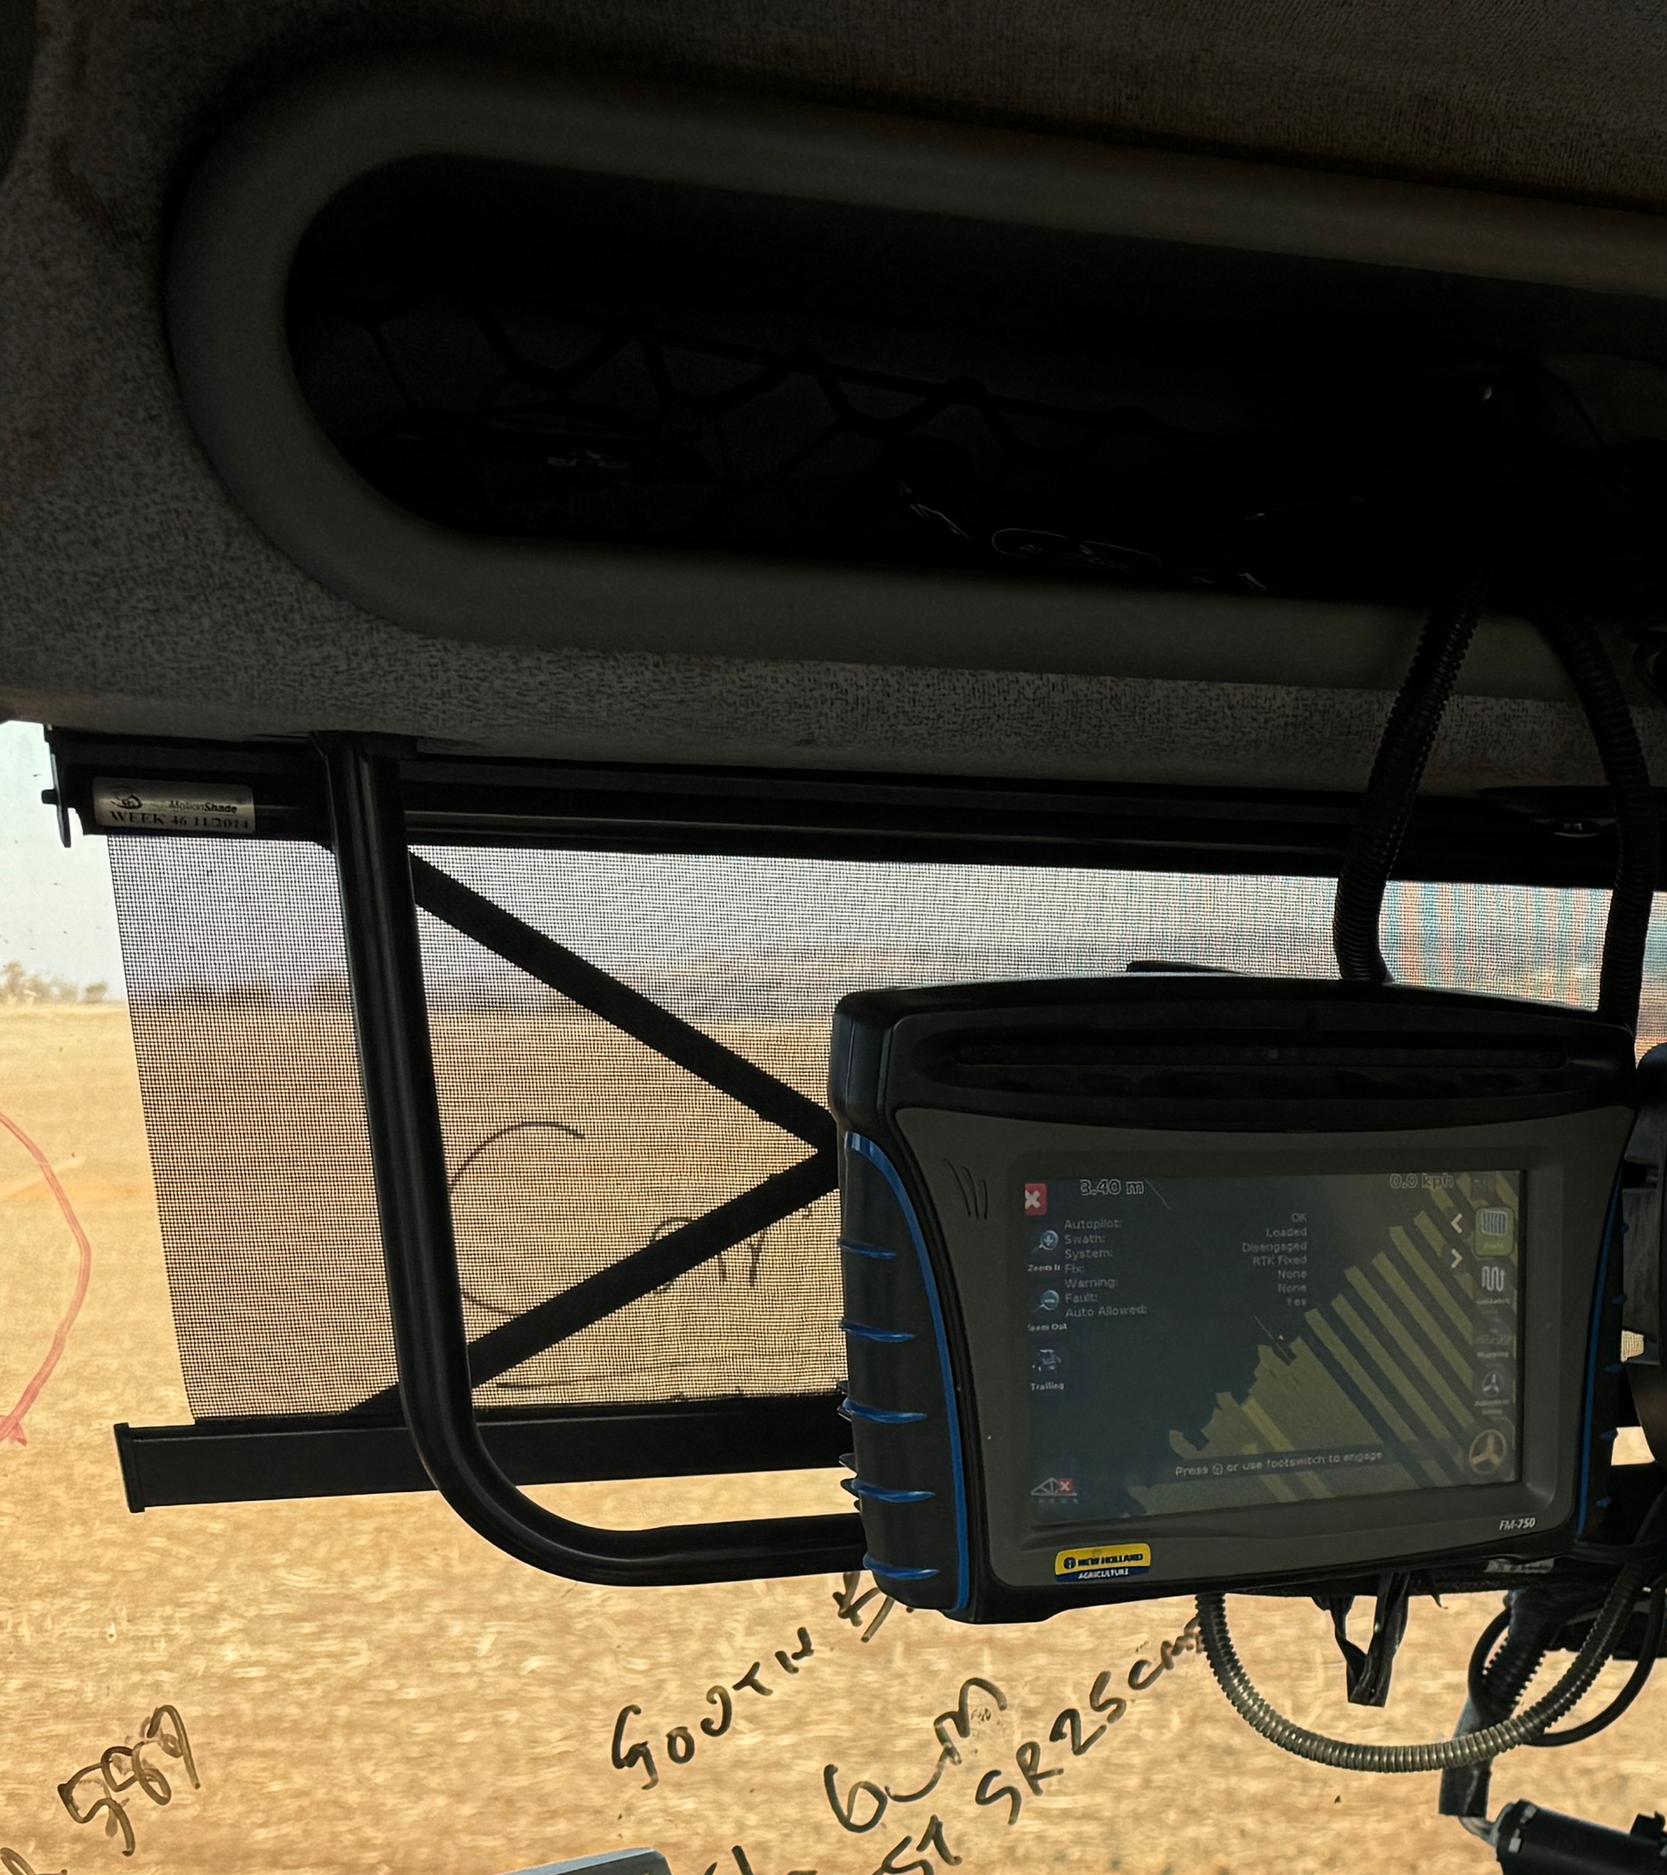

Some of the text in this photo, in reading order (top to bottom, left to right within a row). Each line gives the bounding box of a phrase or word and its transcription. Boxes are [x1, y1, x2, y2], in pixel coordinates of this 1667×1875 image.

[110, 811, 165, 826] WEEK
[1080, 1178, 1146, 1197] 3.40 m
[1064, 1218, 1123, 1232] Autopilot:
[1064, 1233, 1107, 1246] Swath:
[1265, 1227, 1308, 1239] Loaded
[1064, 1247, 1114, 1262] System:
[1242, 1241, 1308, 1255] Disengaged
[1252, 1254, 1308, 1267] RTK Fixed
[1277, 1269, 1308, 1280] None
[1064, 1276, 1119, 1291] Warning:
[1277, 1283, 1308, 1294] None
[1064, 1292, 1099, 1304] Fault:
[1065, 1303, 1148, 1318] Auto Allowed:
[1030, 1380, 1066, 1392] Trailing
[1175, 1463, 1210, 1478] Press
[1242, 1460, 1264, 1472] use
[1266, 1453, 1326, 1470] footswitch
[1343, 1450, 1384, 1466] engage
[1499, 1517, 1537, 1532] FM-750
[1078, 1568, 1130, 1580] AGRICULTURE
